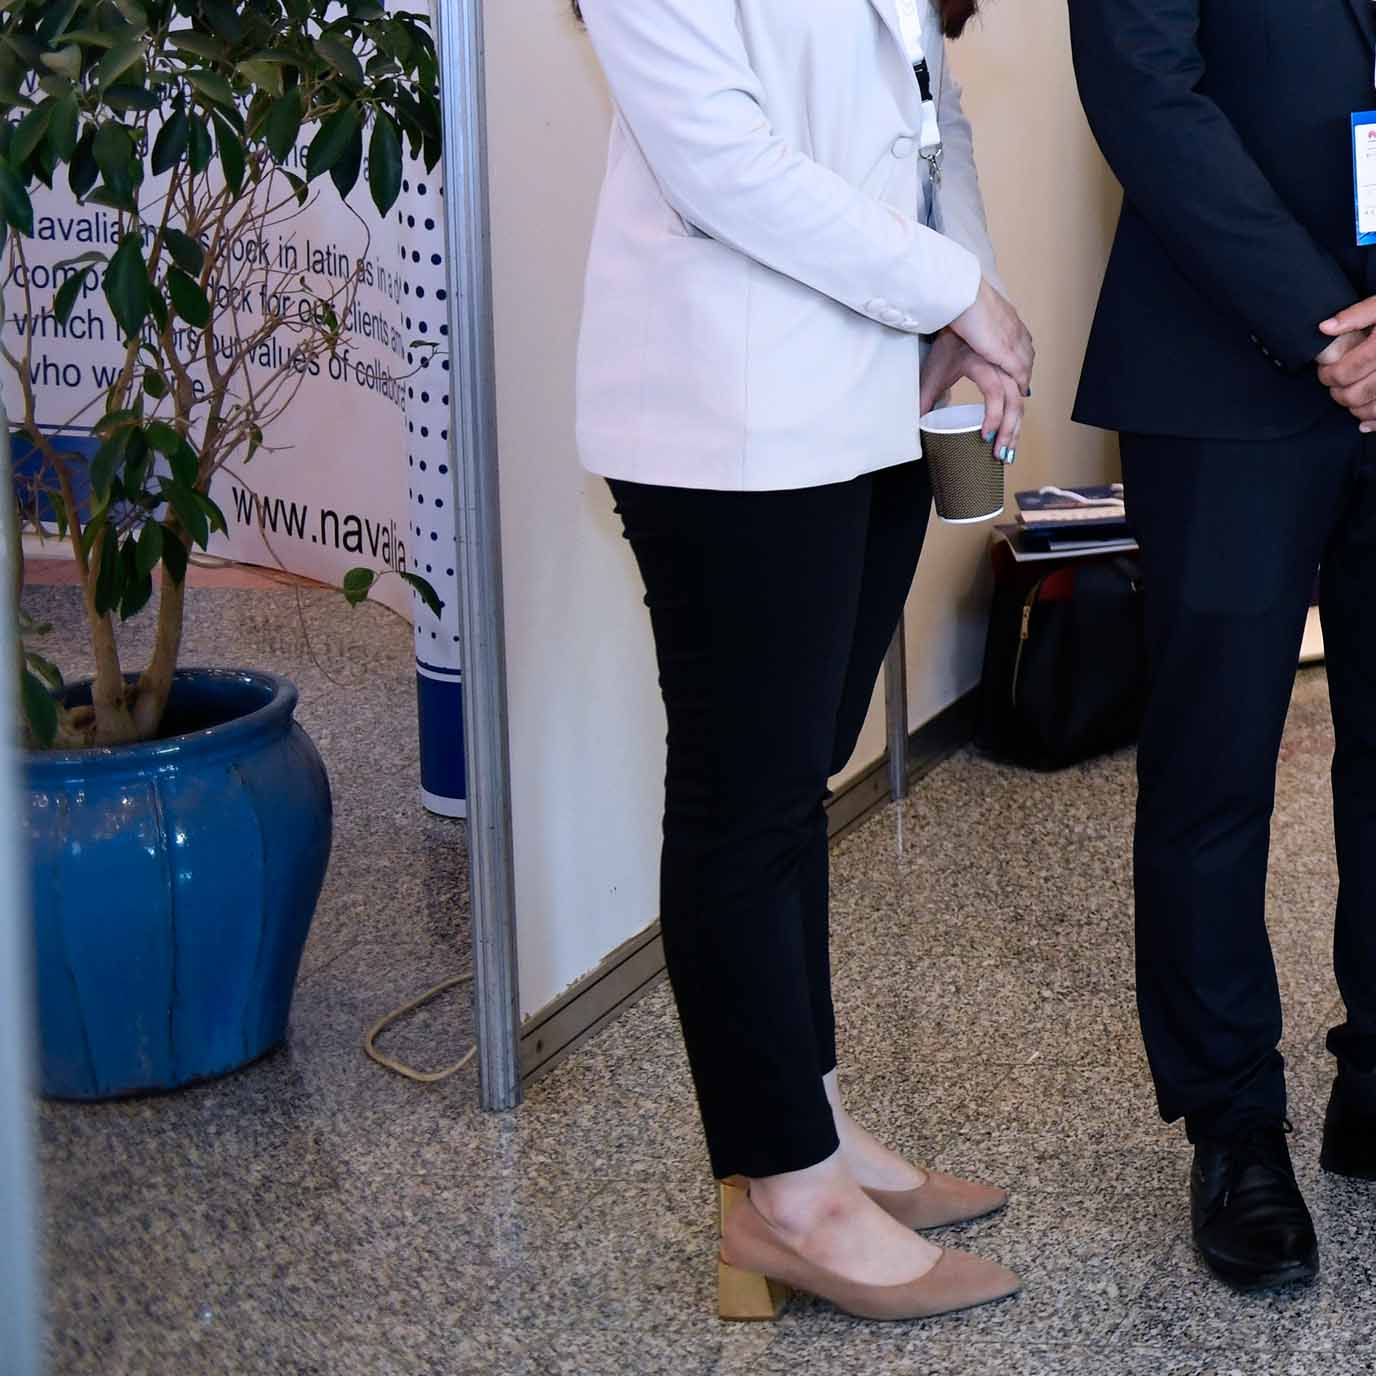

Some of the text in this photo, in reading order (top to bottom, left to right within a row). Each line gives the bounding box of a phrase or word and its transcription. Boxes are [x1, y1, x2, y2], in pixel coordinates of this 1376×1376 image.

[306, 240, 350, 279] latin
[250, 336, 320, 376] values
[329, 348, 350, 382] of
